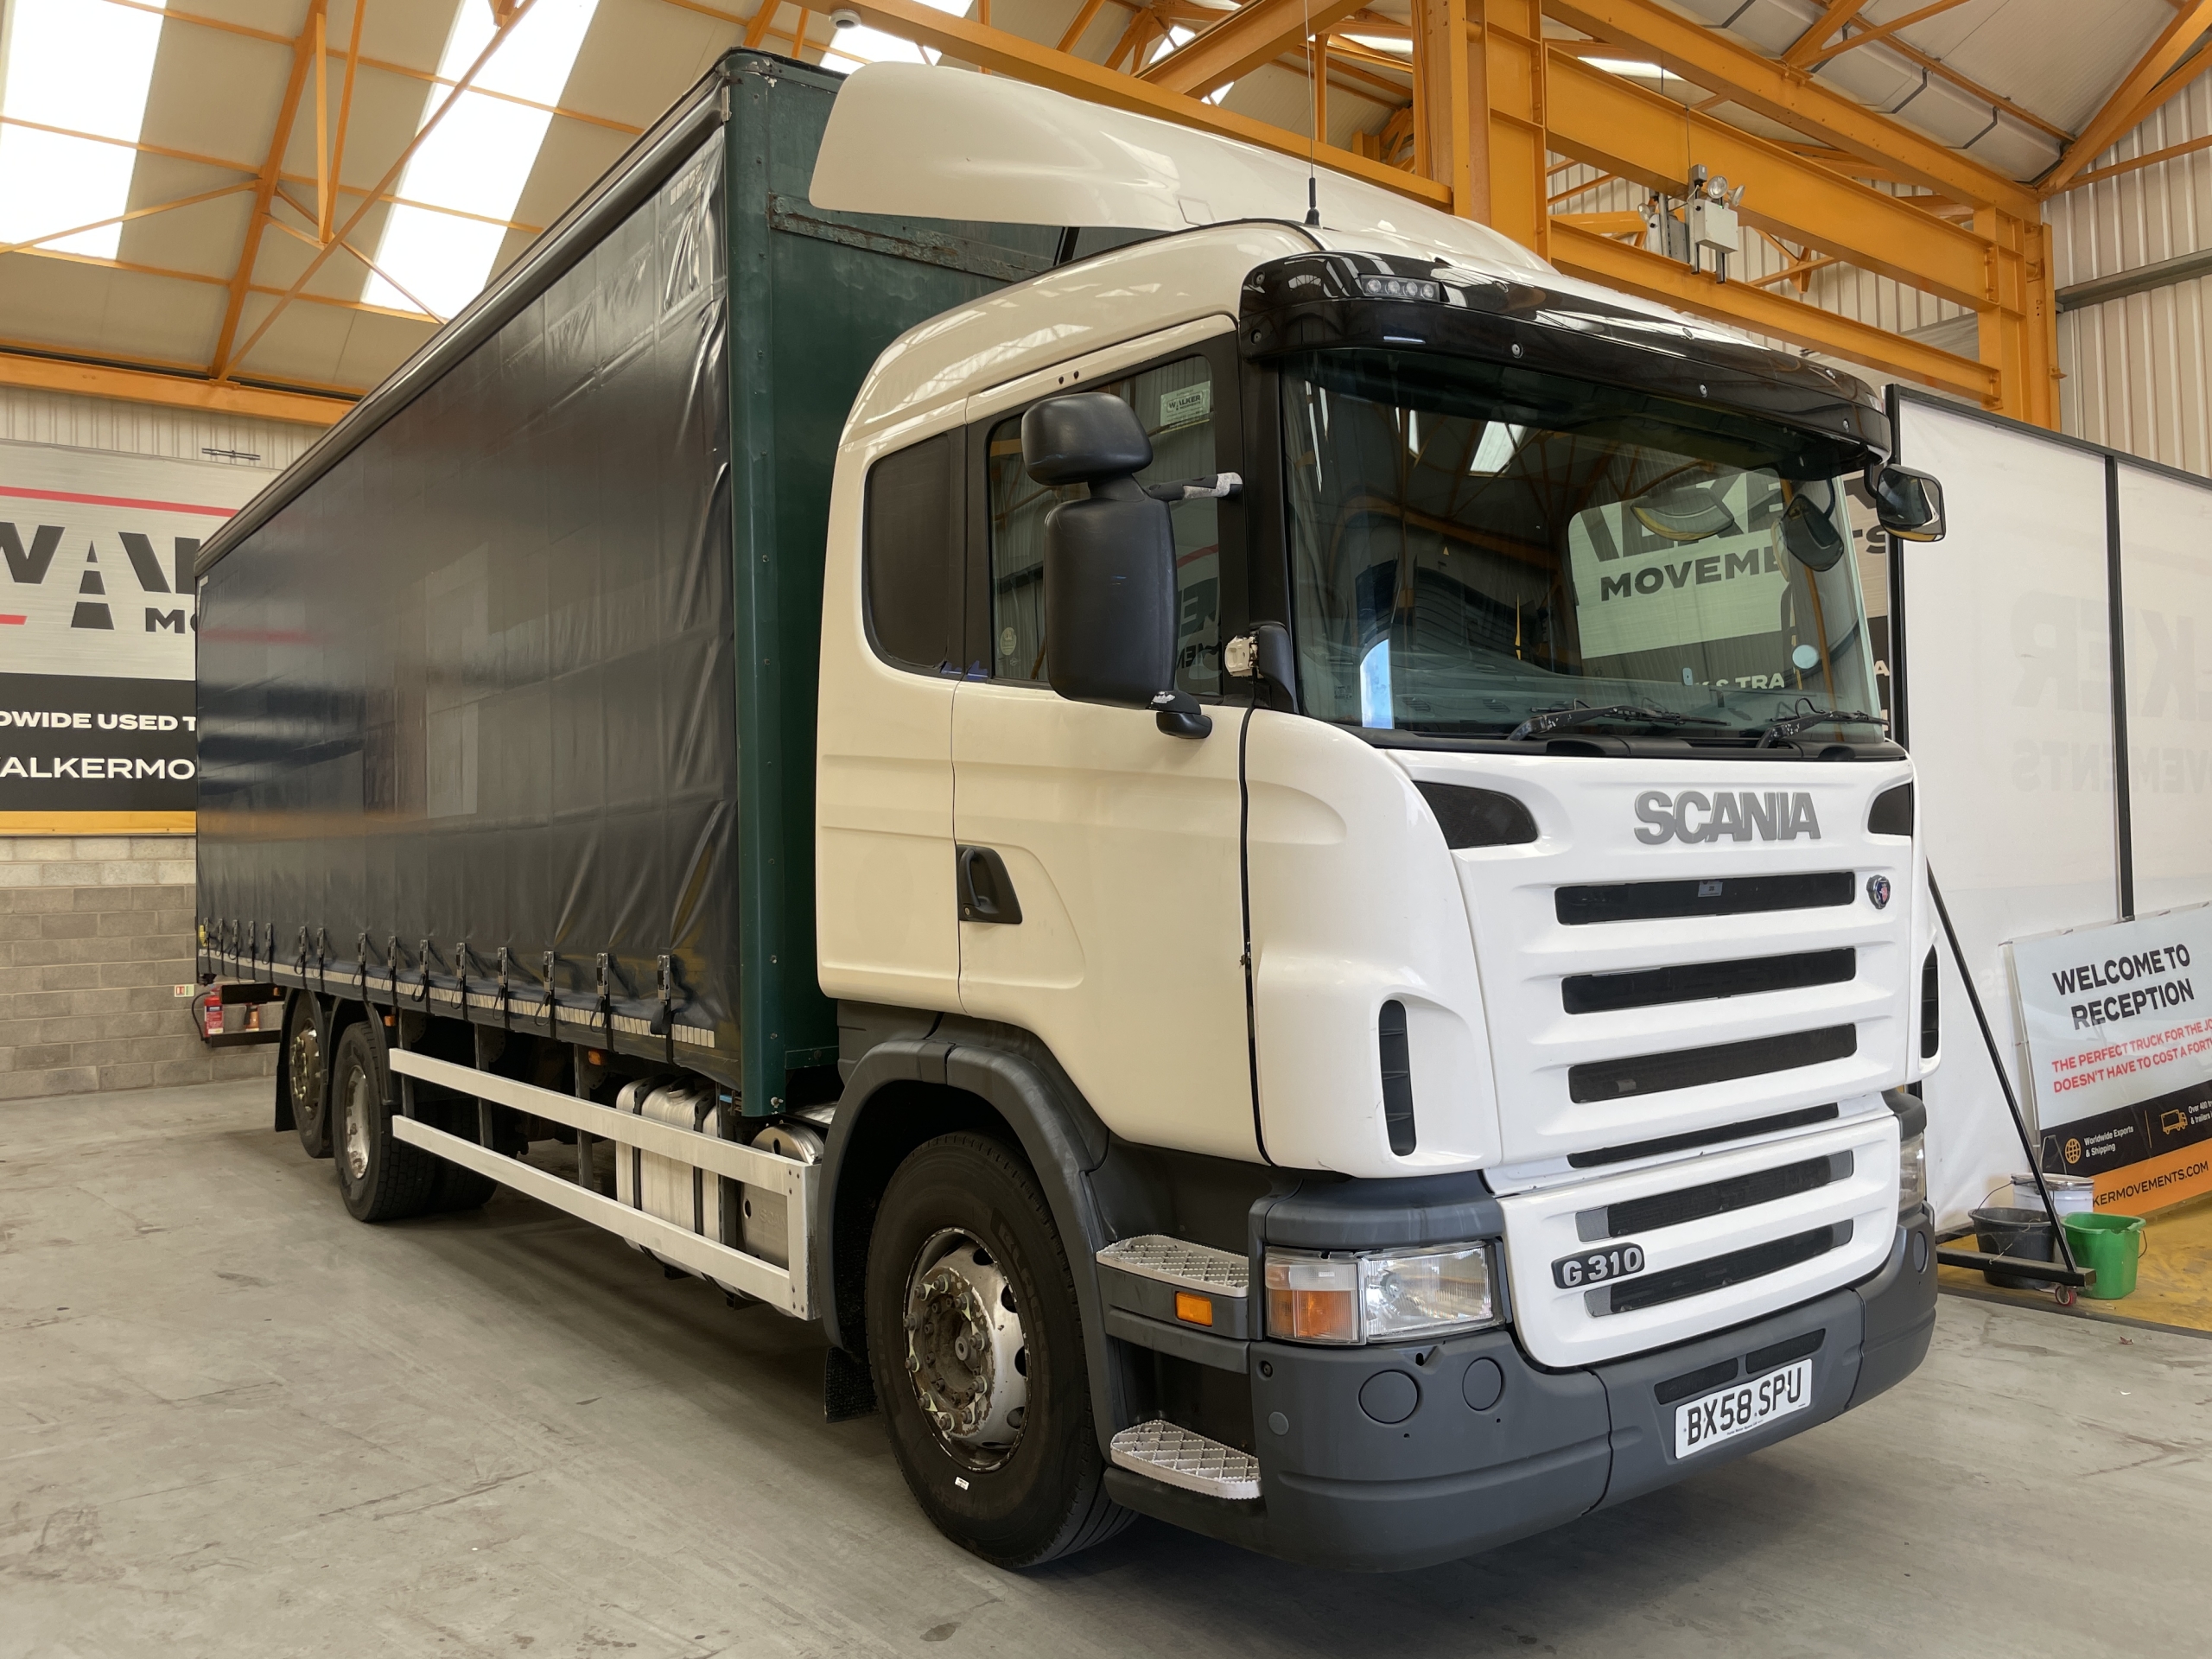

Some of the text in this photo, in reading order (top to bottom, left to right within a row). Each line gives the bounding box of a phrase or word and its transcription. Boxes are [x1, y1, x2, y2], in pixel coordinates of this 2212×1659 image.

[98, 714, 178, 731] USED
[1634, 790, 1821, 845] SCANIA
[2052, 944, 2190, 995] WELCOME TO
[2071, 978, 2195, 1030] RECEPTION
[2052, 1056, 2076, 1073] THE
[2078, 1042, 2128, 1066] PERFECT
[2129, 1033, 2164, 1052] TRUCK
[2164, 1027, 2185, 1044] FOR
[2184, 1022, 2203, 1037] THE
[2053, 1069, 2104, 1093] DOESN'T
[2107, 1061, 2136, 1078] HAVE
[2137, 1056, 2152, 1070] TO
[2152, 1048, 2178, 1065] COST
[2180, 1047, 2188, 1058] A
[2083, 1125, 2134, 1146] Worldwide Exports
[2085, 1143, 2115, 1158] & Shipping
[2093, 1160, 2209, 1207] KERMOVEMENTS.COM
[1688, 1367, 1802, 1446] BX58 SPU
